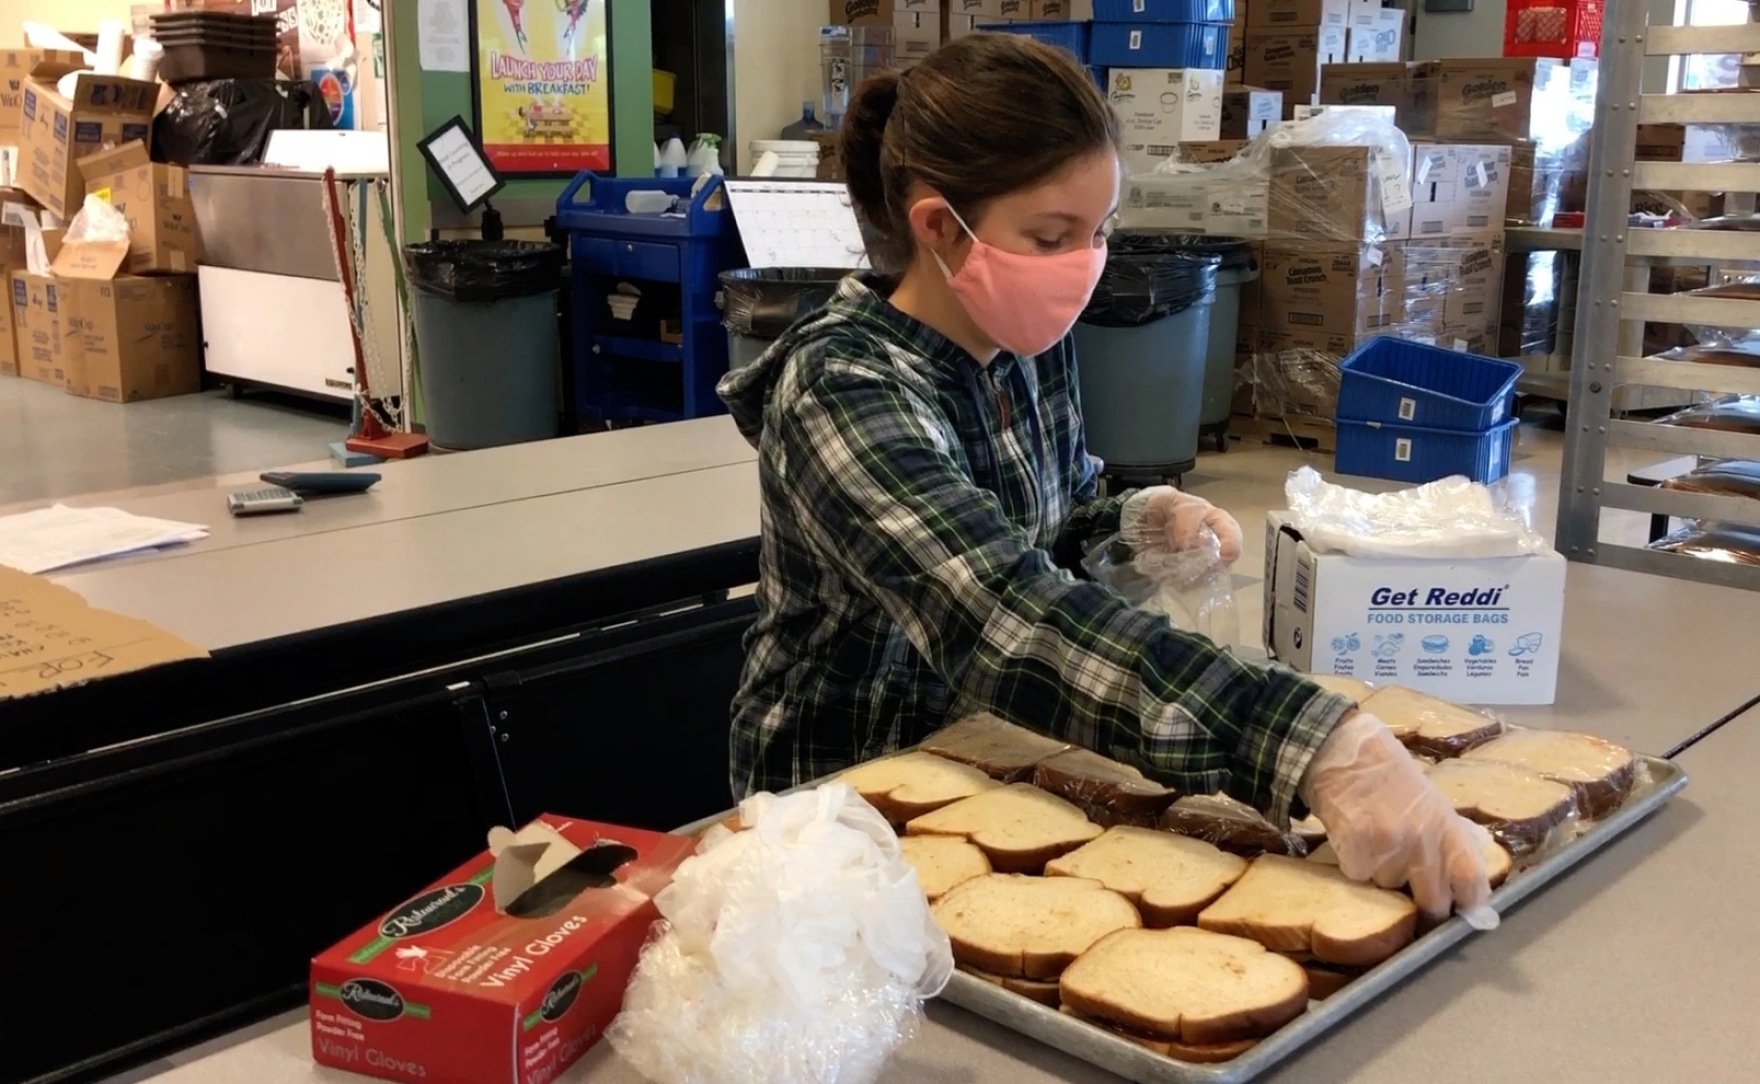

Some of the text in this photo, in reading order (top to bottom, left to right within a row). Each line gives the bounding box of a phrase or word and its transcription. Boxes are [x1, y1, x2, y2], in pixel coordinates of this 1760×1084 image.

[491, 51, 598, 82] LAUNCH YOUR DAY
[504, 82, 590, 95] WITH BREAKFAST!
[1286, 274, 1328, 285] Toast Crunch
[1288, 265, 1323, 277] Cinnamon
[1371, 587, 1419, 606] Get
[1367, 613, 1509, 624] FOOD STORAGE BAGS
[480, 915, 588, 987] Vinyl Gloves
[461, 947, 512, 983] Powder Free
[316, 1021, 365, 1041] Powder Free
[319, 1037, 427, 1078] Vinyl Gloves
